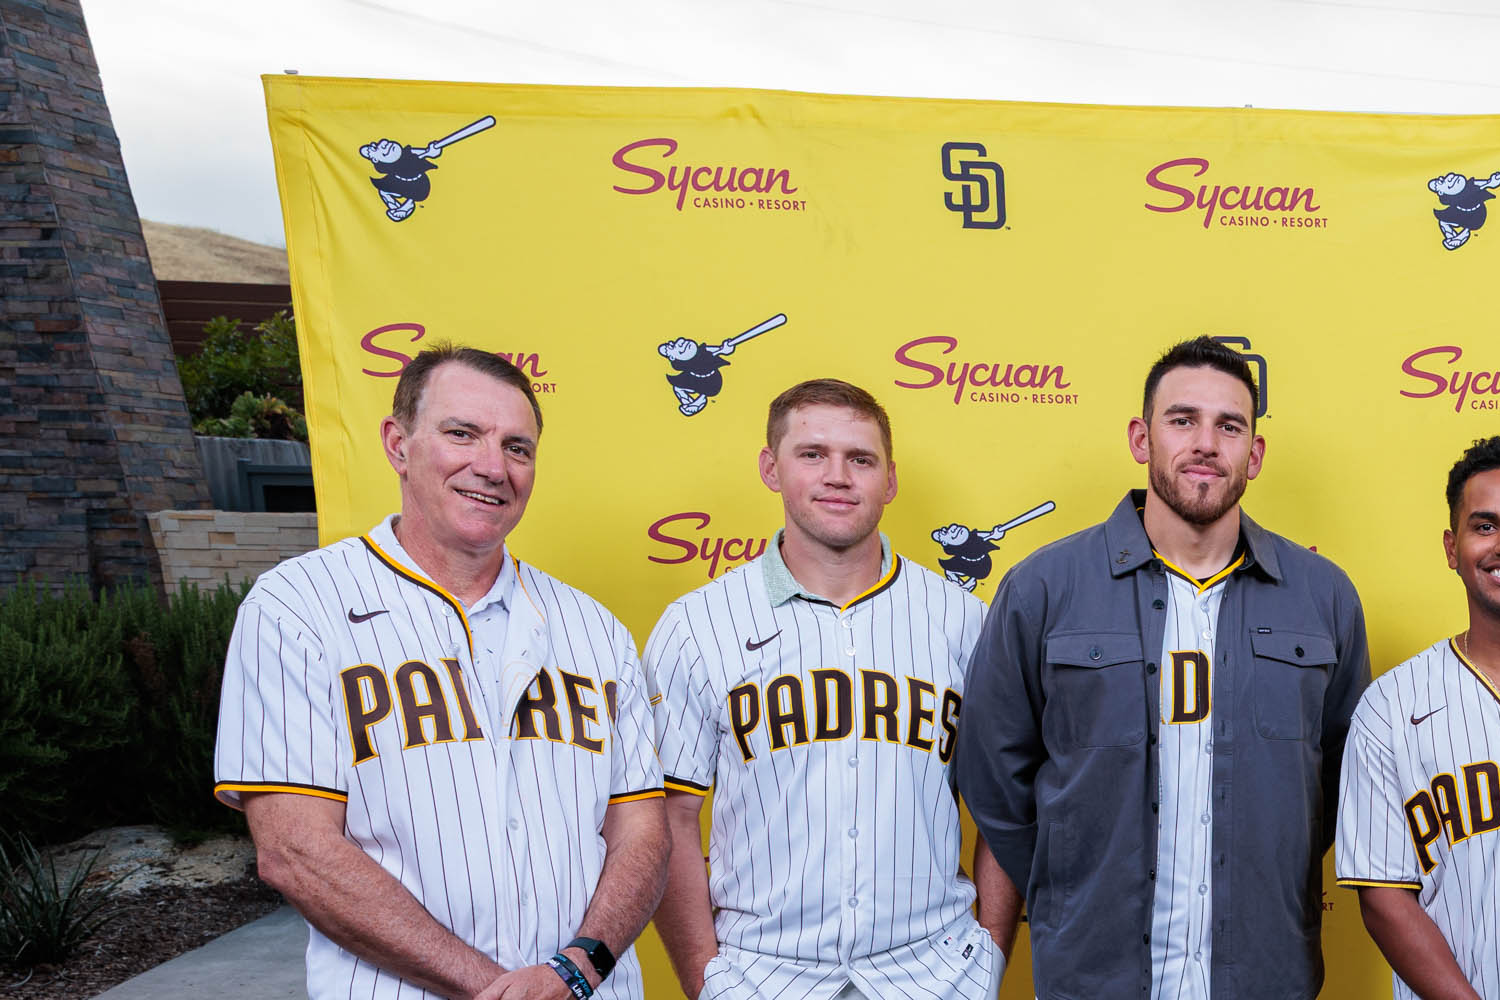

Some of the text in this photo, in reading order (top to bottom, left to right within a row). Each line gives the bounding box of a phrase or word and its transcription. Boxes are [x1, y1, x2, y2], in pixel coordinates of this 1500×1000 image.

[612, 138, 798, 212] Sycuan
[693, 198, 807, 211] CASINO RESORT
[1144, 158, 1321, 229] Sycuan
[1220, 216, 1328, 228] CASINO RESORT
[894, 336, 1071, 405] Sycuan
[970, 392, 1079, 405] CASINO RESORT
[648, 512, 767, 578] Sycu
[728, 667, 964, 765] PADRES
